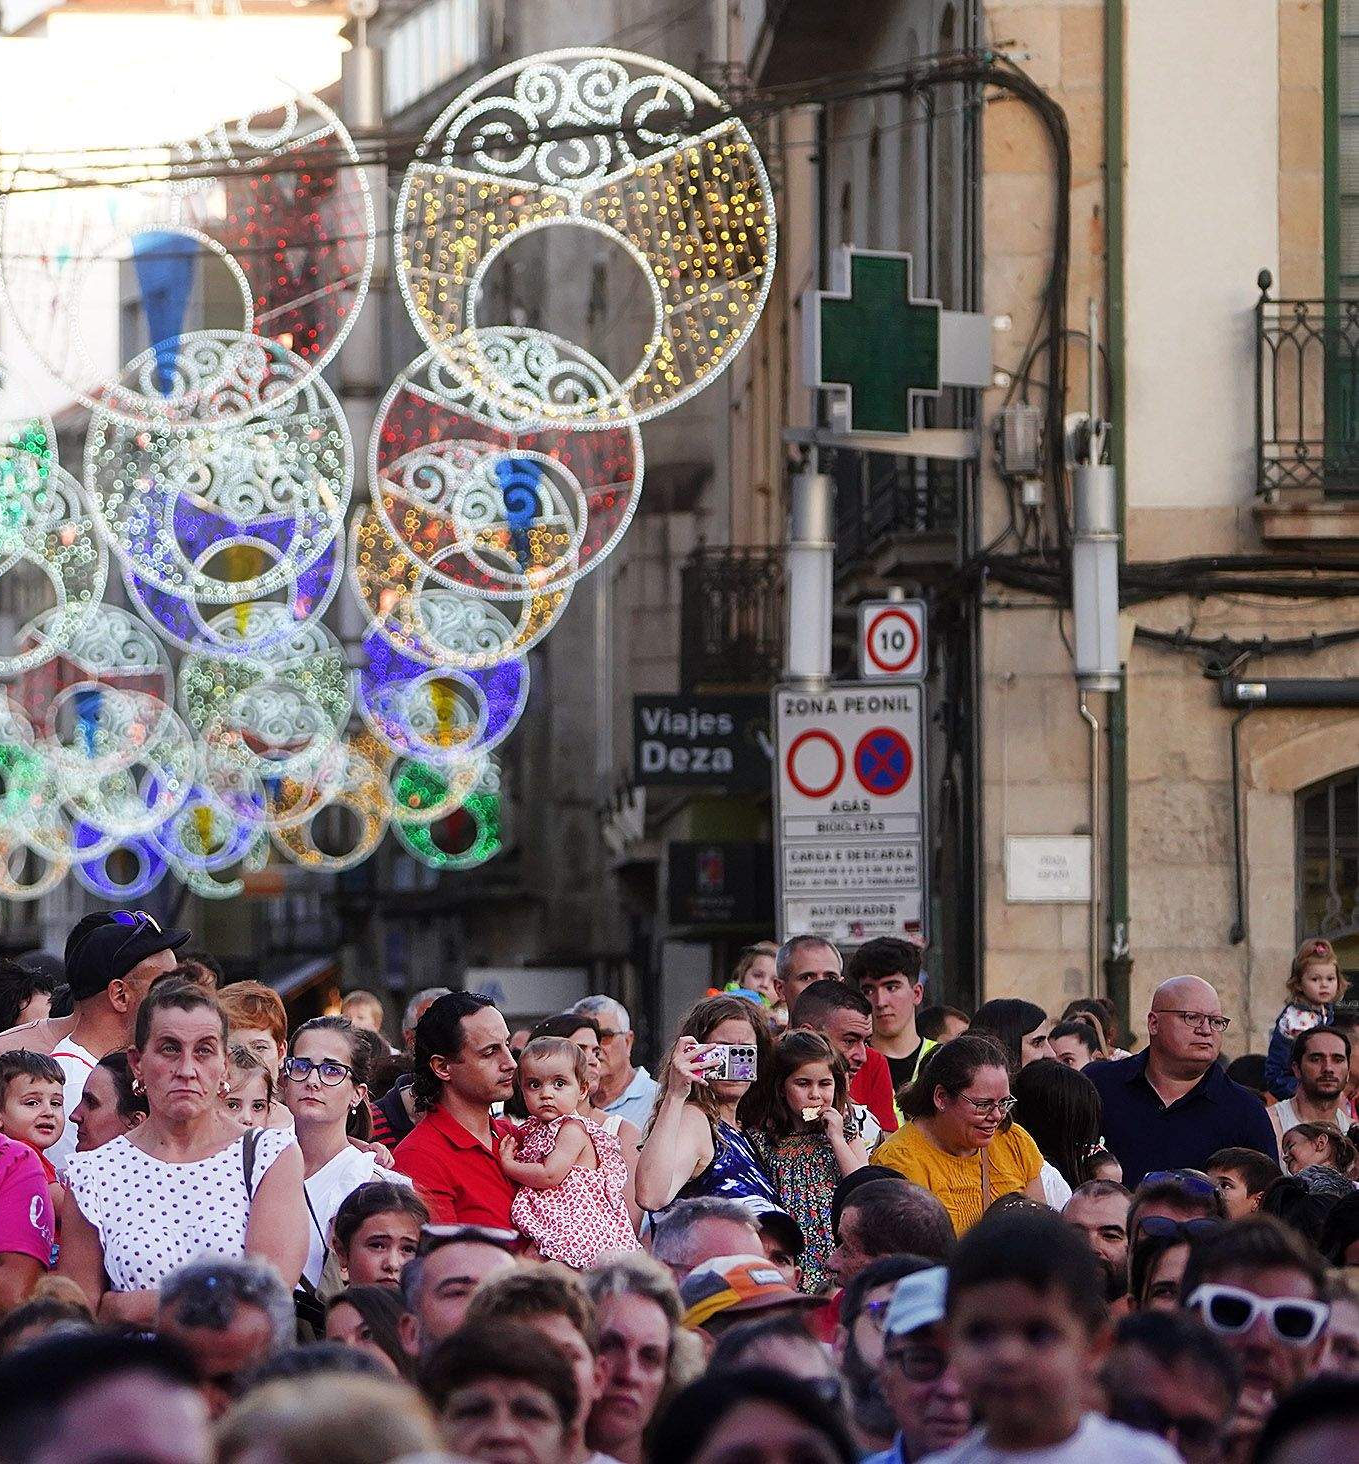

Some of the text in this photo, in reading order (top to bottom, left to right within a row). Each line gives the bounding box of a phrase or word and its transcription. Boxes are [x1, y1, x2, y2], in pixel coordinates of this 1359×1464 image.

[881, 630, 905, 651] 10
[785, 695, 912, 716] ZONA PEONIL
[642, 707, 733, 739] Viajes
[642, 741, 733, 772] Deza
